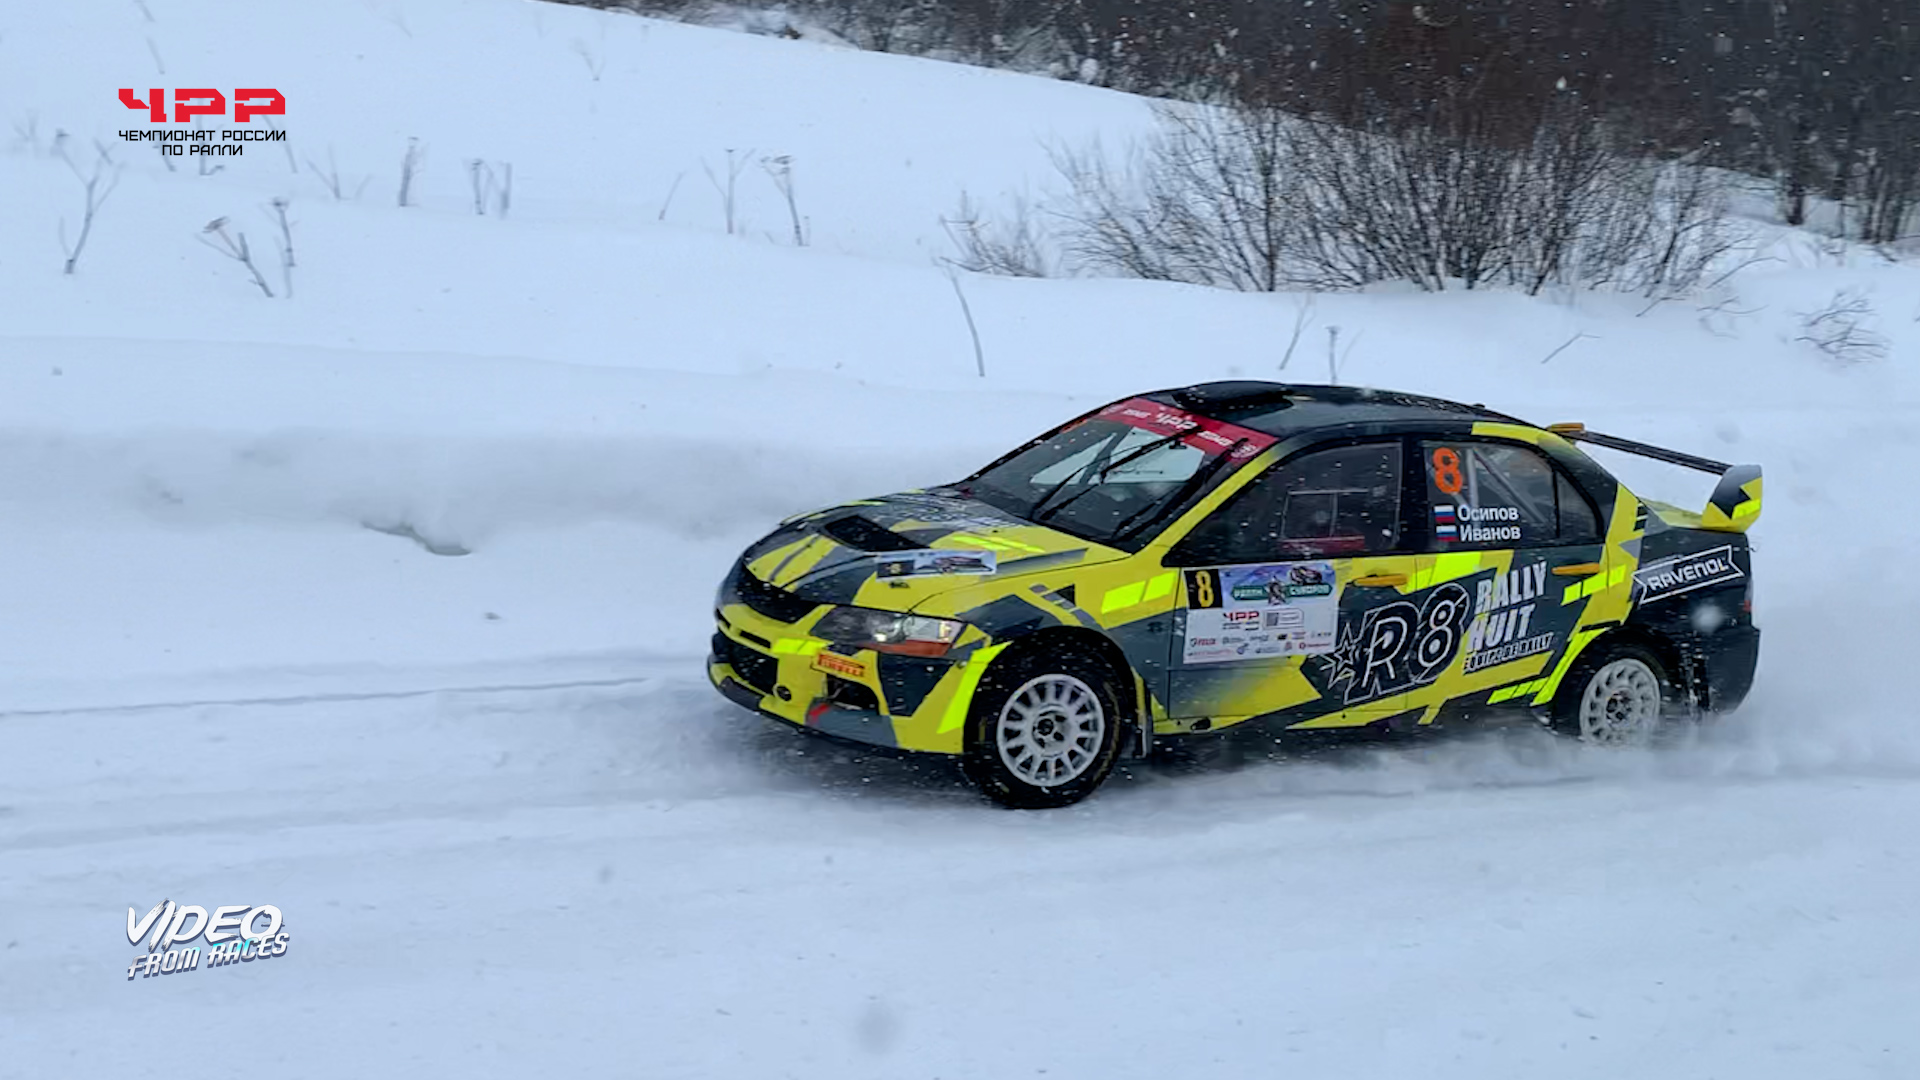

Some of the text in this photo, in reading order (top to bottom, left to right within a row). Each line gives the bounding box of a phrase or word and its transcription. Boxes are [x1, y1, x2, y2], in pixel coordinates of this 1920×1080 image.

[1432, 447, 1463, 494] 8
[1457, 506, 1519, 521] Осипов
[1460, 525, 1521, 542] Иванов
[1196, 570, 1214, 608] 8
[1474, 561, 1547, 615] RALLY
[1647, 558, 1729, 591] RAVENOL
[1344, 582, 1470, 705] R8
[1466, 604, 1536, 651] HUIT
